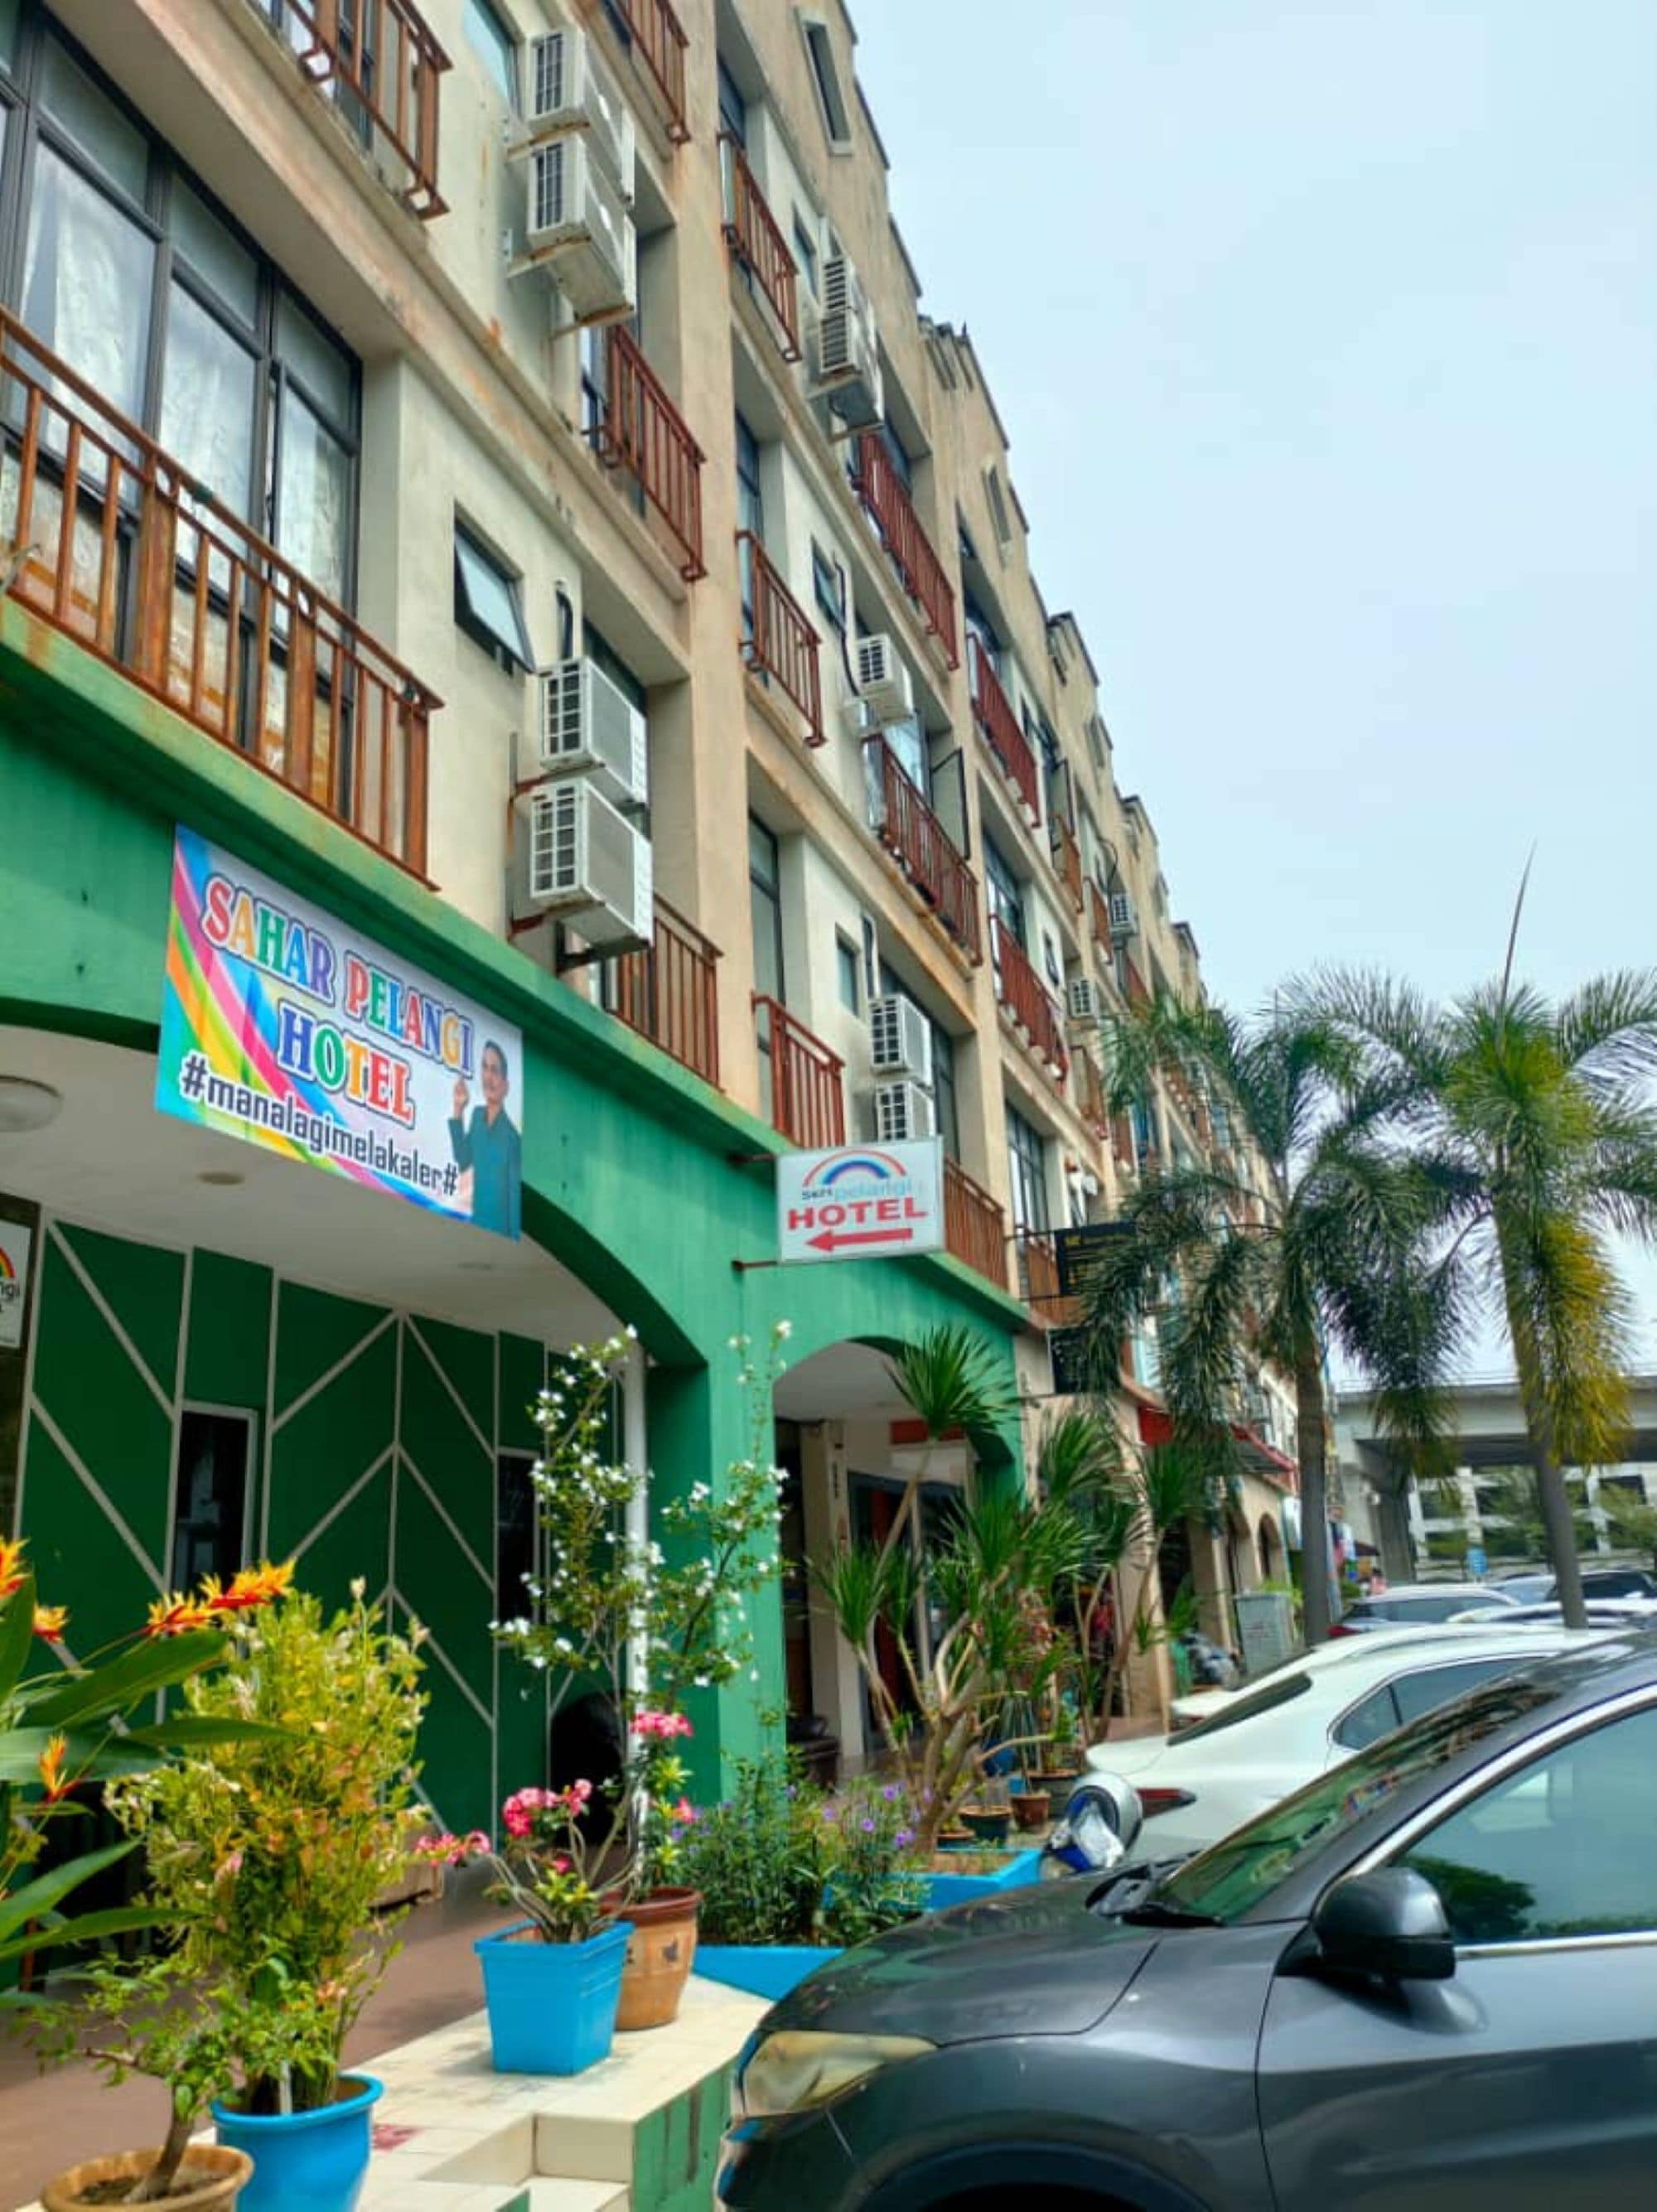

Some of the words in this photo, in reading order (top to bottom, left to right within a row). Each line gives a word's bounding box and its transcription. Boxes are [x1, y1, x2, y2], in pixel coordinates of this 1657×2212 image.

[203, 875, 335, 1004] SAHAR
[345, 952, 472, 1076] PELANGI
[181, 1054, 458, 1196] #manalagimelakaler#
[278, 1000, 414, 1127] HOTEL
[788, 1197, 927, 1230] HOTEL
